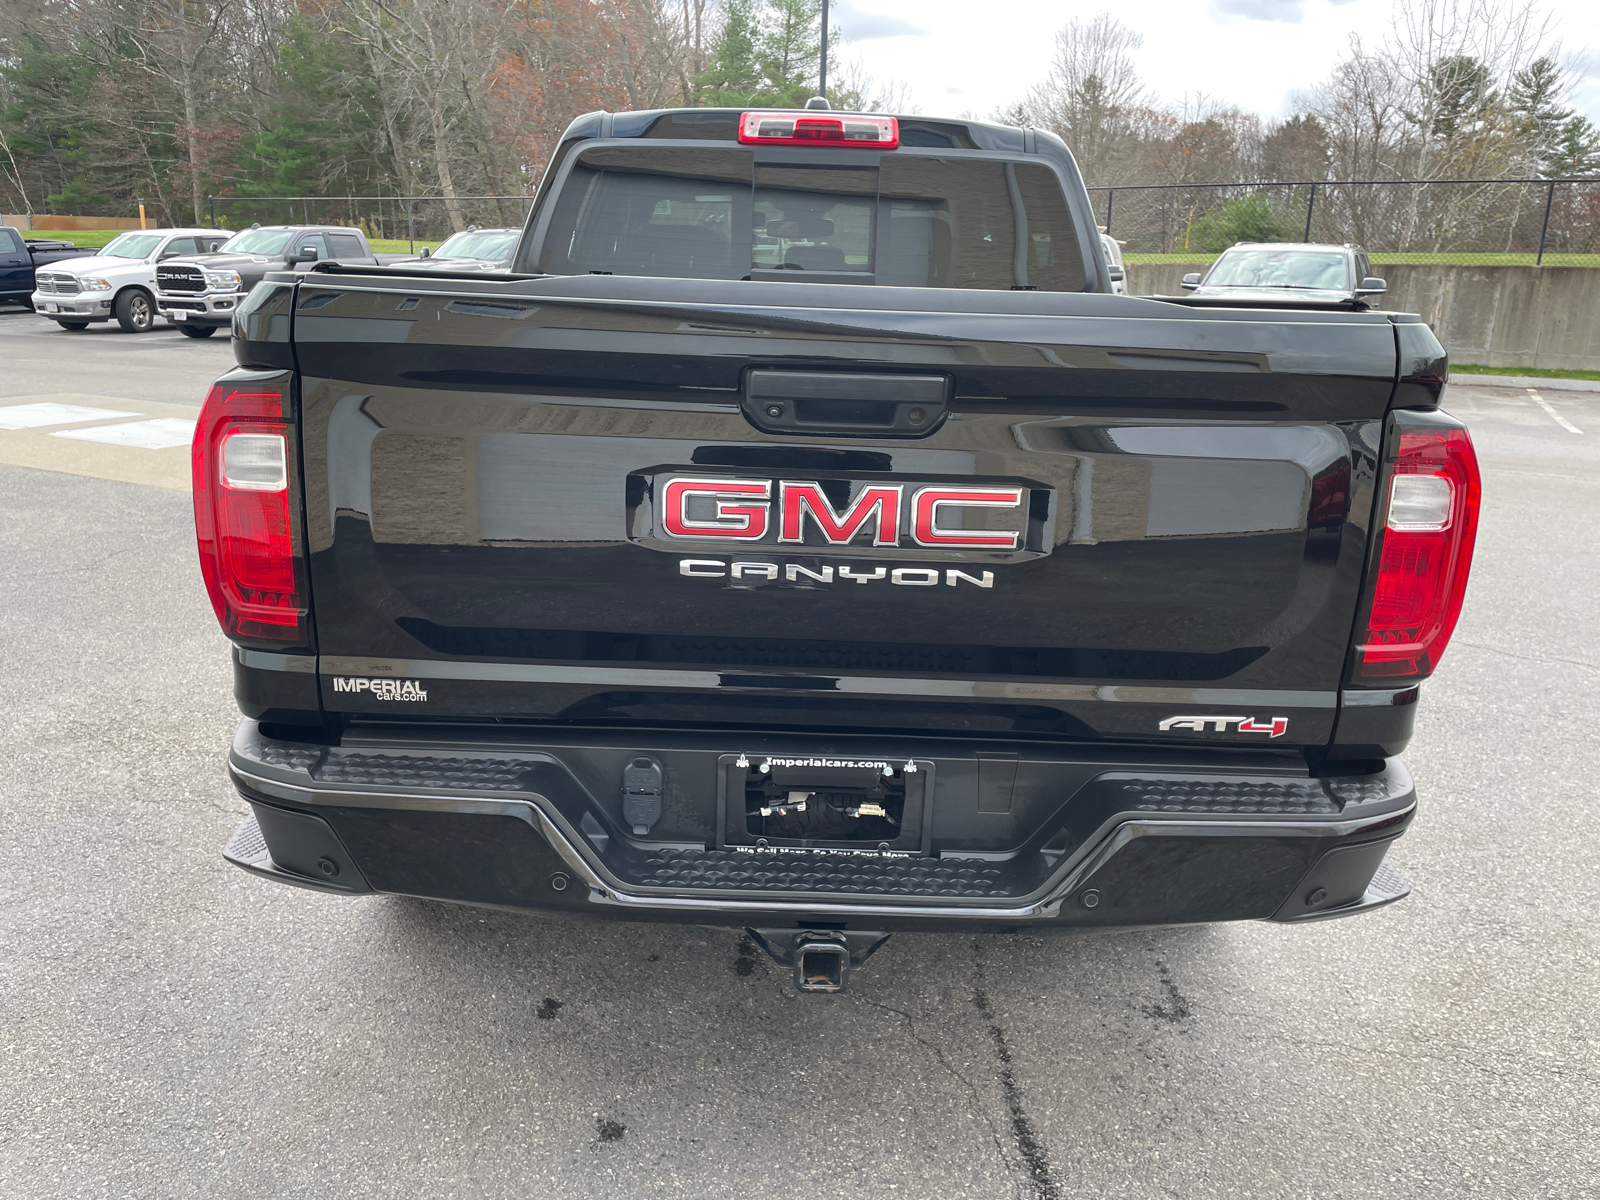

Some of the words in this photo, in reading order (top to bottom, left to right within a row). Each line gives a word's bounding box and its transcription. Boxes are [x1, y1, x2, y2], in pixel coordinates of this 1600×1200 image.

[662, 477, 1023, 549] GMC
[679, 558, 995, 589] CANYON
[333, 677, 428, 695] IMPERIAL
[376, 692, 428, 702] cars.com
[1158, 715, 1289, 739] AT4
[766, 757, 888, 768] Imperialcars.com
